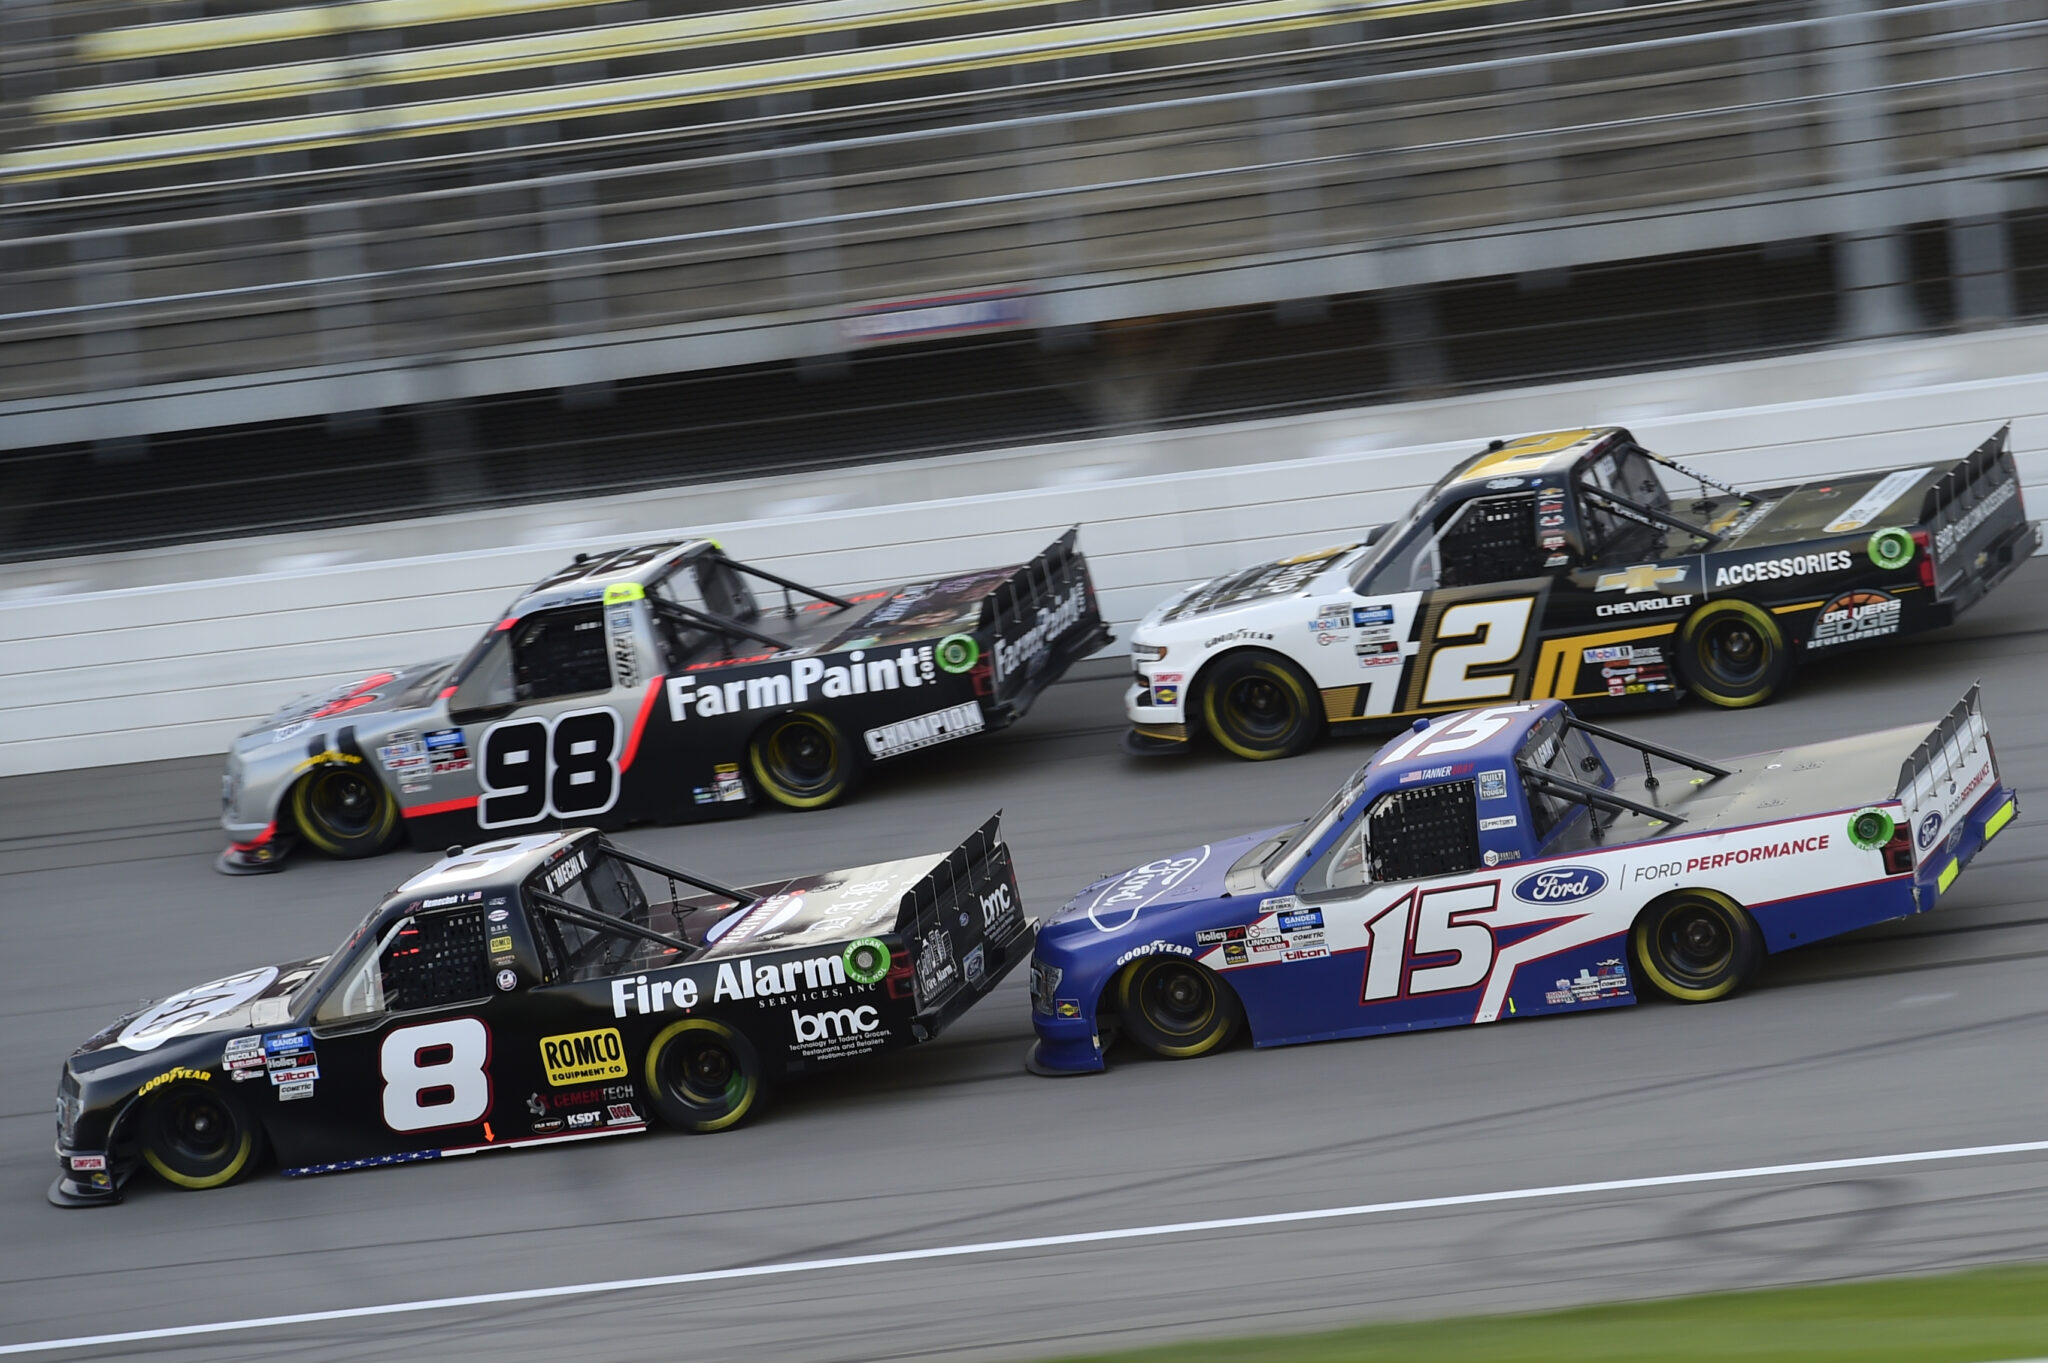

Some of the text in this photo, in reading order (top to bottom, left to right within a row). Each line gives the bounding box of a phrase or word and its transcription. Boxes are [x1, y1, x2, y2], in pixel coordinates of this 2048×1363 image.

[1715, 550, 1853, 587] ACCESSORIES
[1596, 594, 1692, 617] CHEVROLET
[1308, 619, 1337, 631] Mobil
[1814, 611, 1900, 639] EDGE
[1807, 625, 1898, 649] DEVELOPMENT
[1422, 597, 1537, 704] 2
[1586, 649, 1617, 660] Mobil
[666, 646, 936, 722] FarmPaint .com
[868, 702, 983, 753] CHAMPION
[479, 706, 622, 829] 98
[1422, 766, 1453, 780] TANNER
[1482, 773, 1503, 782] BUILT
[1635, 835, 1830, 882] FORD PERFORMANCE
[1533, 871, 1589, 898] Ford
[980, 883, 1010, 928] bmc
[1285, 914, 1316, 924] GANDER
[1198, 932, 1227, 943] Holley
[1247, 936, 1282, 947] LINCOLN
[1293, 932, 1324, 941] COMETIC
[1362, 880, 1500, 1004] 15
[844, 939, 880, 960] AMERICAN
[1116, 940, 1193, 966] GOODYEAR
[1284, 948, 1327, 961] tilton
[611, 955, 846, 1018] Fire Alarm
[759, 989, 843, 1008] SERVICES,
[791, 1005, 880, 1043] bmc
[272, 1037, 304, 1048] GANDER
[545, 1032, 621, 1070] ROMCO
[789, 1040, 827, 1051] Technology
[802, 1046, 840, 1057] Restaurants
[224, 1051, 258, 1062] LINCOLN
[268, 1058, 297, 1068] Holley
[138, 1066, 212, 1096] GOODYEAR
[274, 1070, 316, 1082] tilton
[381, 1017, 491, 1132] 8
[552, 1065, 624, 1081] EQUIPMENT CO.
[281, 1083, 312, 1093] COMETIC
[567, 1111, 601, 1126] KSDT
[74, 1159, 102, 1168] SIMPSON
